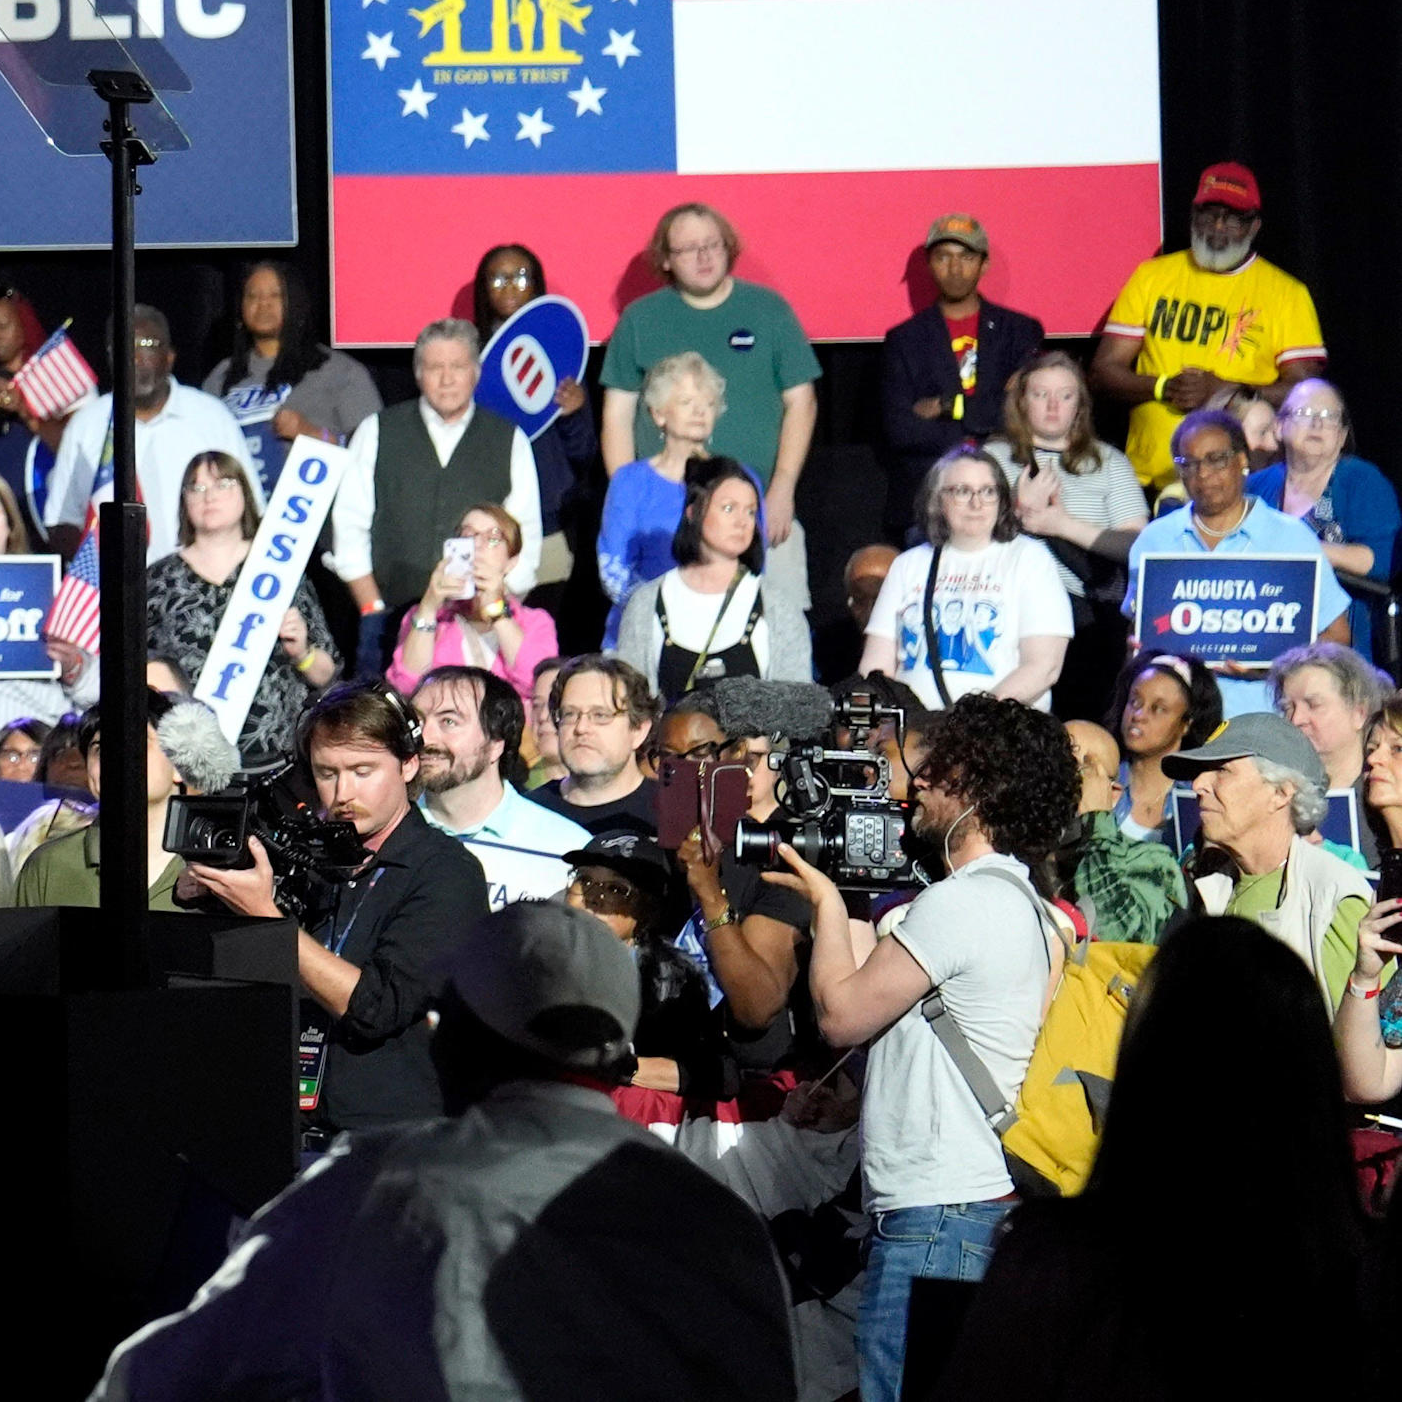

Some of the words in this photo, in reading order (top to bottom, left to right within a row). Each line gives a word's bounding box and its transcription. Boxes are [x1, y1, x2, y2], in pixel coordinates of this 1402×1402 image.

[434, 69, 452, 84] IN
[454, 69, 489, 84] GOD
[491, 69, 516, 84] WE
[520, 68, 569, 84] TRUST
[1172, 579, 1257, 601] AUGUSTA
[1260, 582, 1285, 597] for
[1169, 601, 1302, 636] Ossoff
